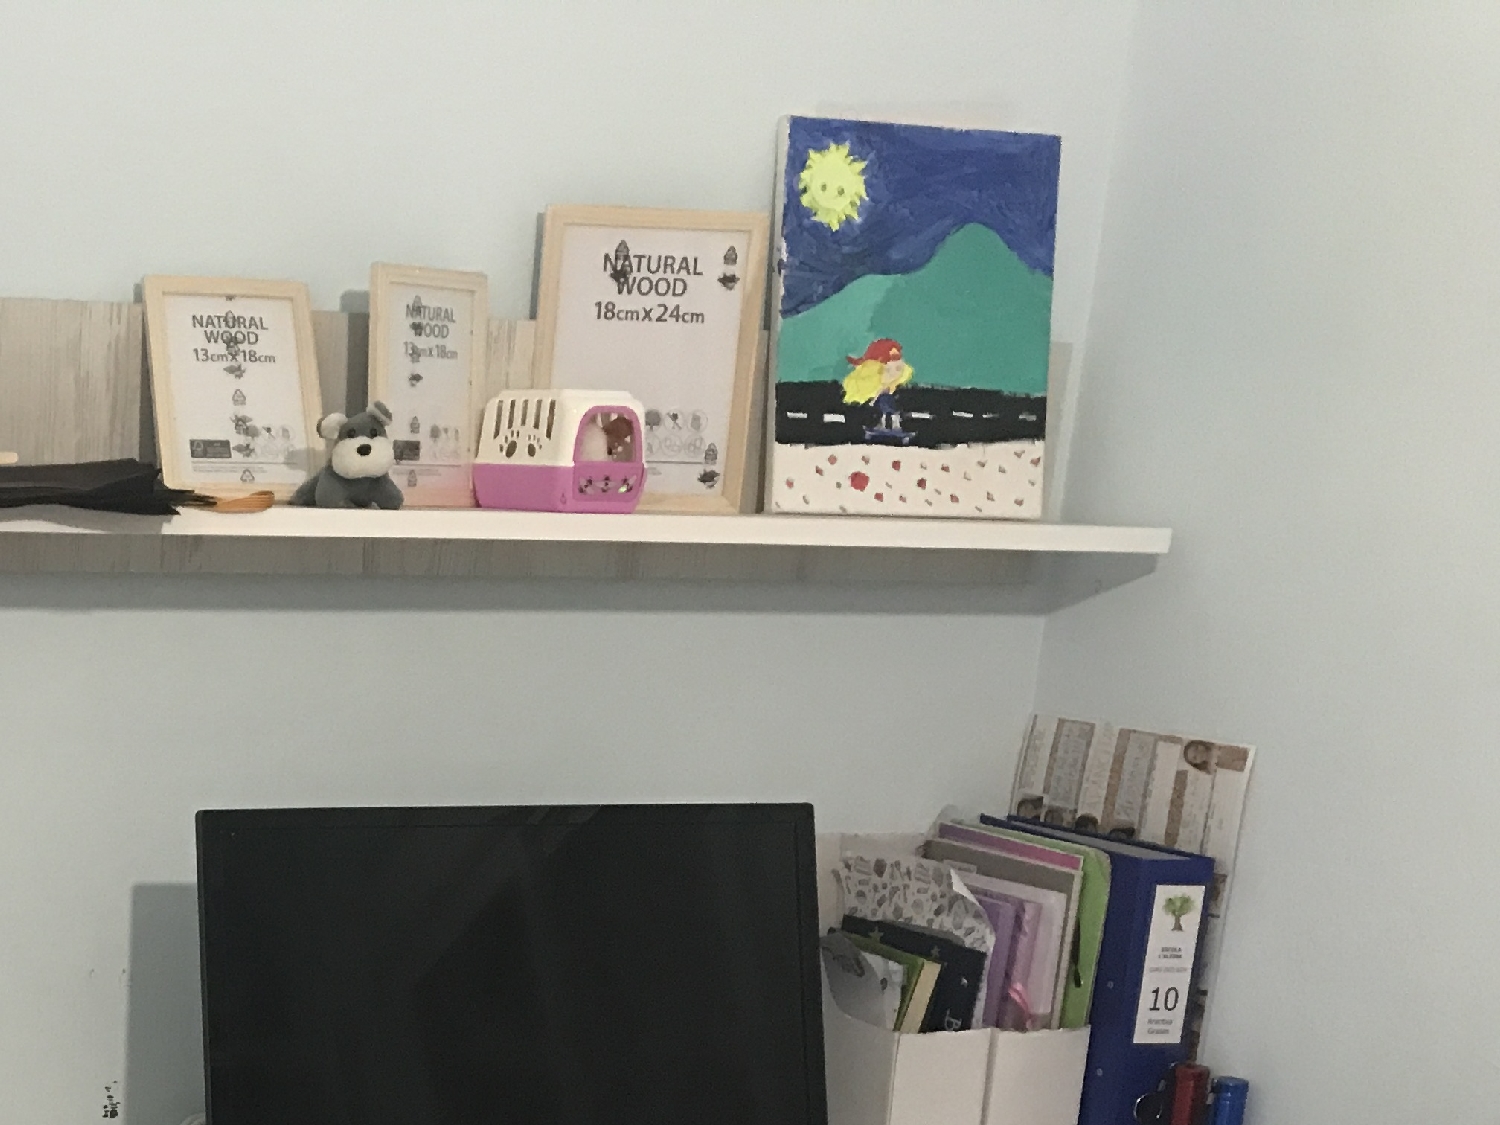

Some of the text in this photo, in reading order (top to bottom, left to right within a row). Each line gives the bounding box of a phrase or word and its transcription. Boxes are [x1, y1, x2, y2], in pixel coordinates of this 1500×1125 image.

[603, 252, 704, 276] NATURAL
[617, 276, 688, 297] WOOD
[192, 314, 269, 330] NATURAL
[204, 330, 259, 345] WOOD
[1149, 986, 1180, 1011] 10
